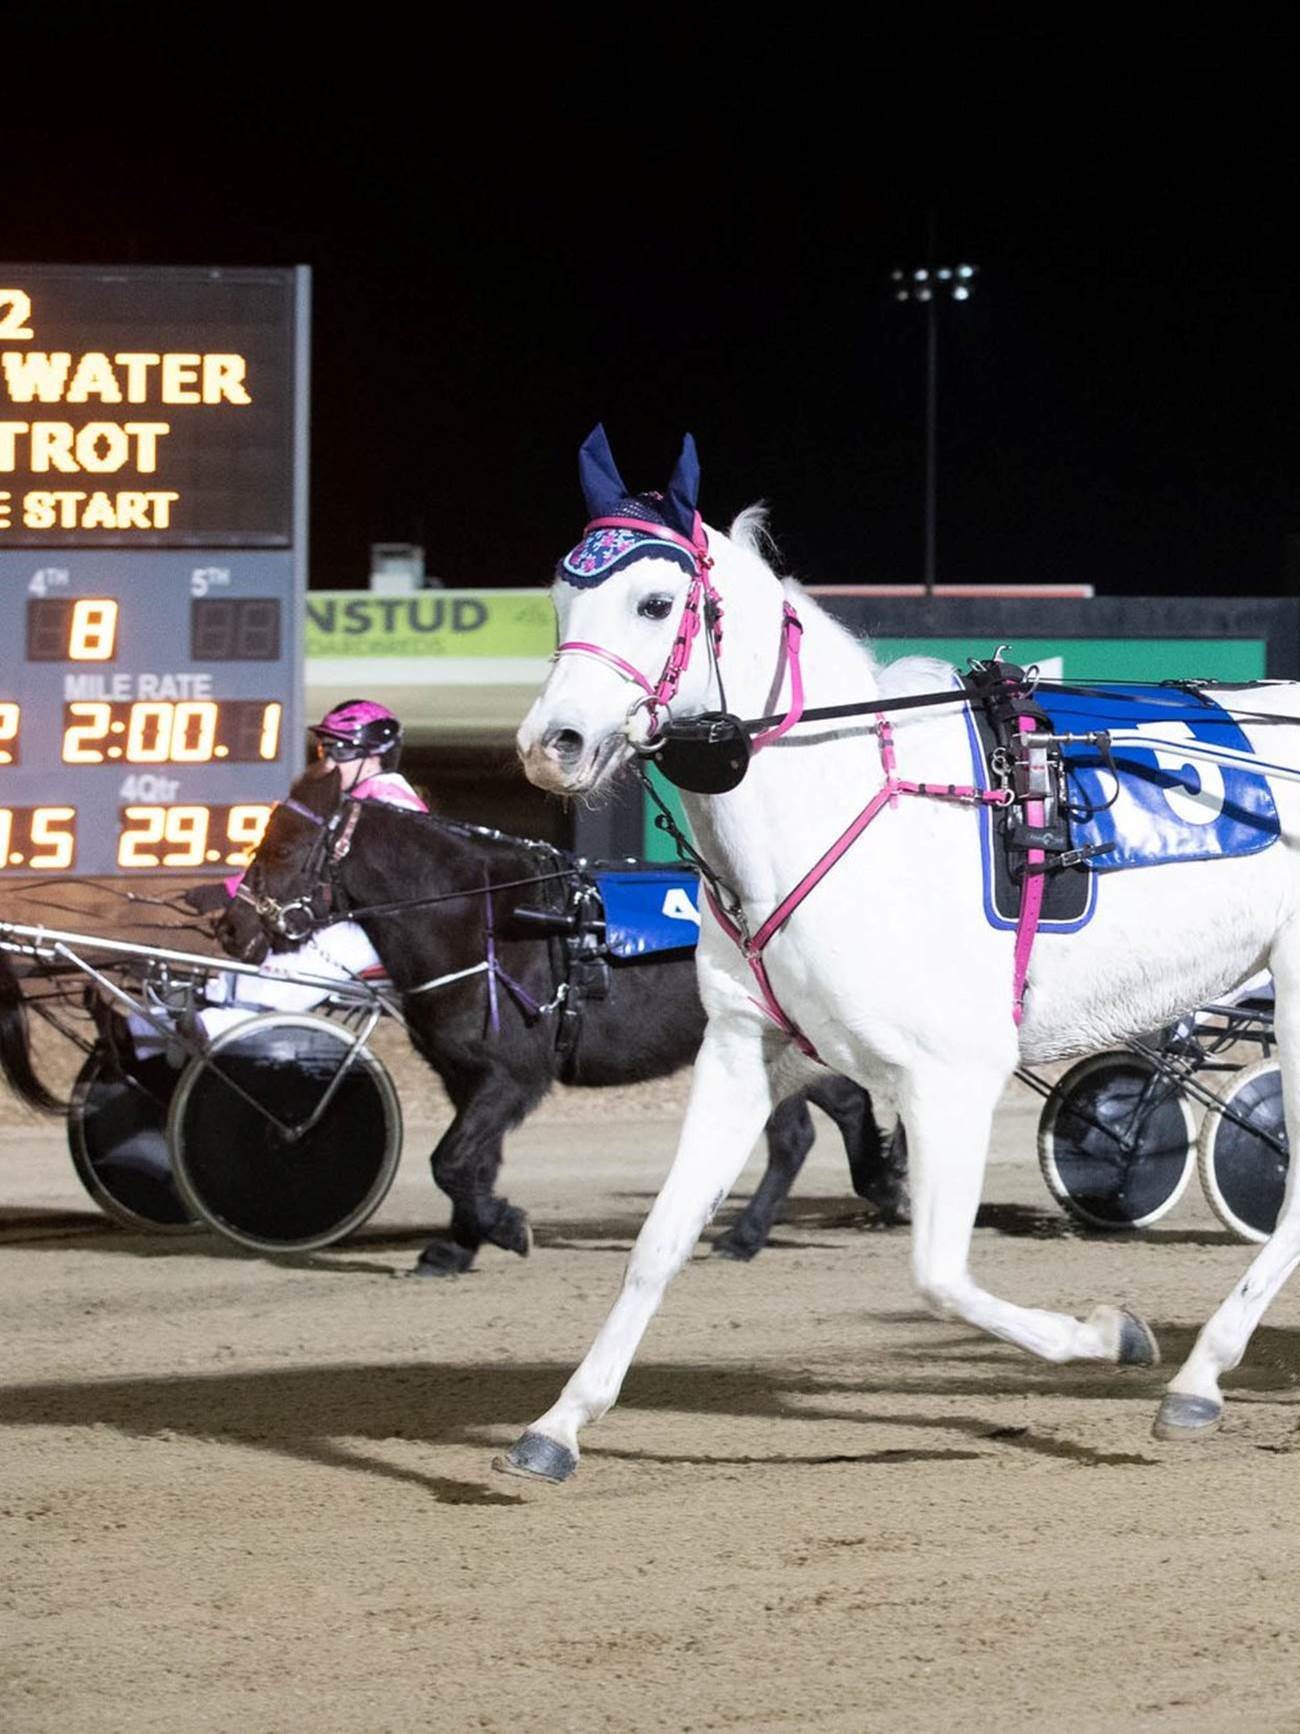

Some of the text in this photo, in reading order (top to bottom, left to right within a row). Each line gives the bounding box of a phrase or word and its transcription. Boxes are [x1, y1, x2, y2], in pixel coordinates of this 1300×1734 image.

[0, 289, 34, 339] 2
[1, 352, 252, 404] WATER
[0, 422, 170, 472] TROT
[23, 491, 180, 528] START
[69, 600, 118, 660] 8
[64, 674, 213, 701] MILE RATE
[1136, 721, 1225, 826] 5
[118, 806, 273, 868] 29.9
